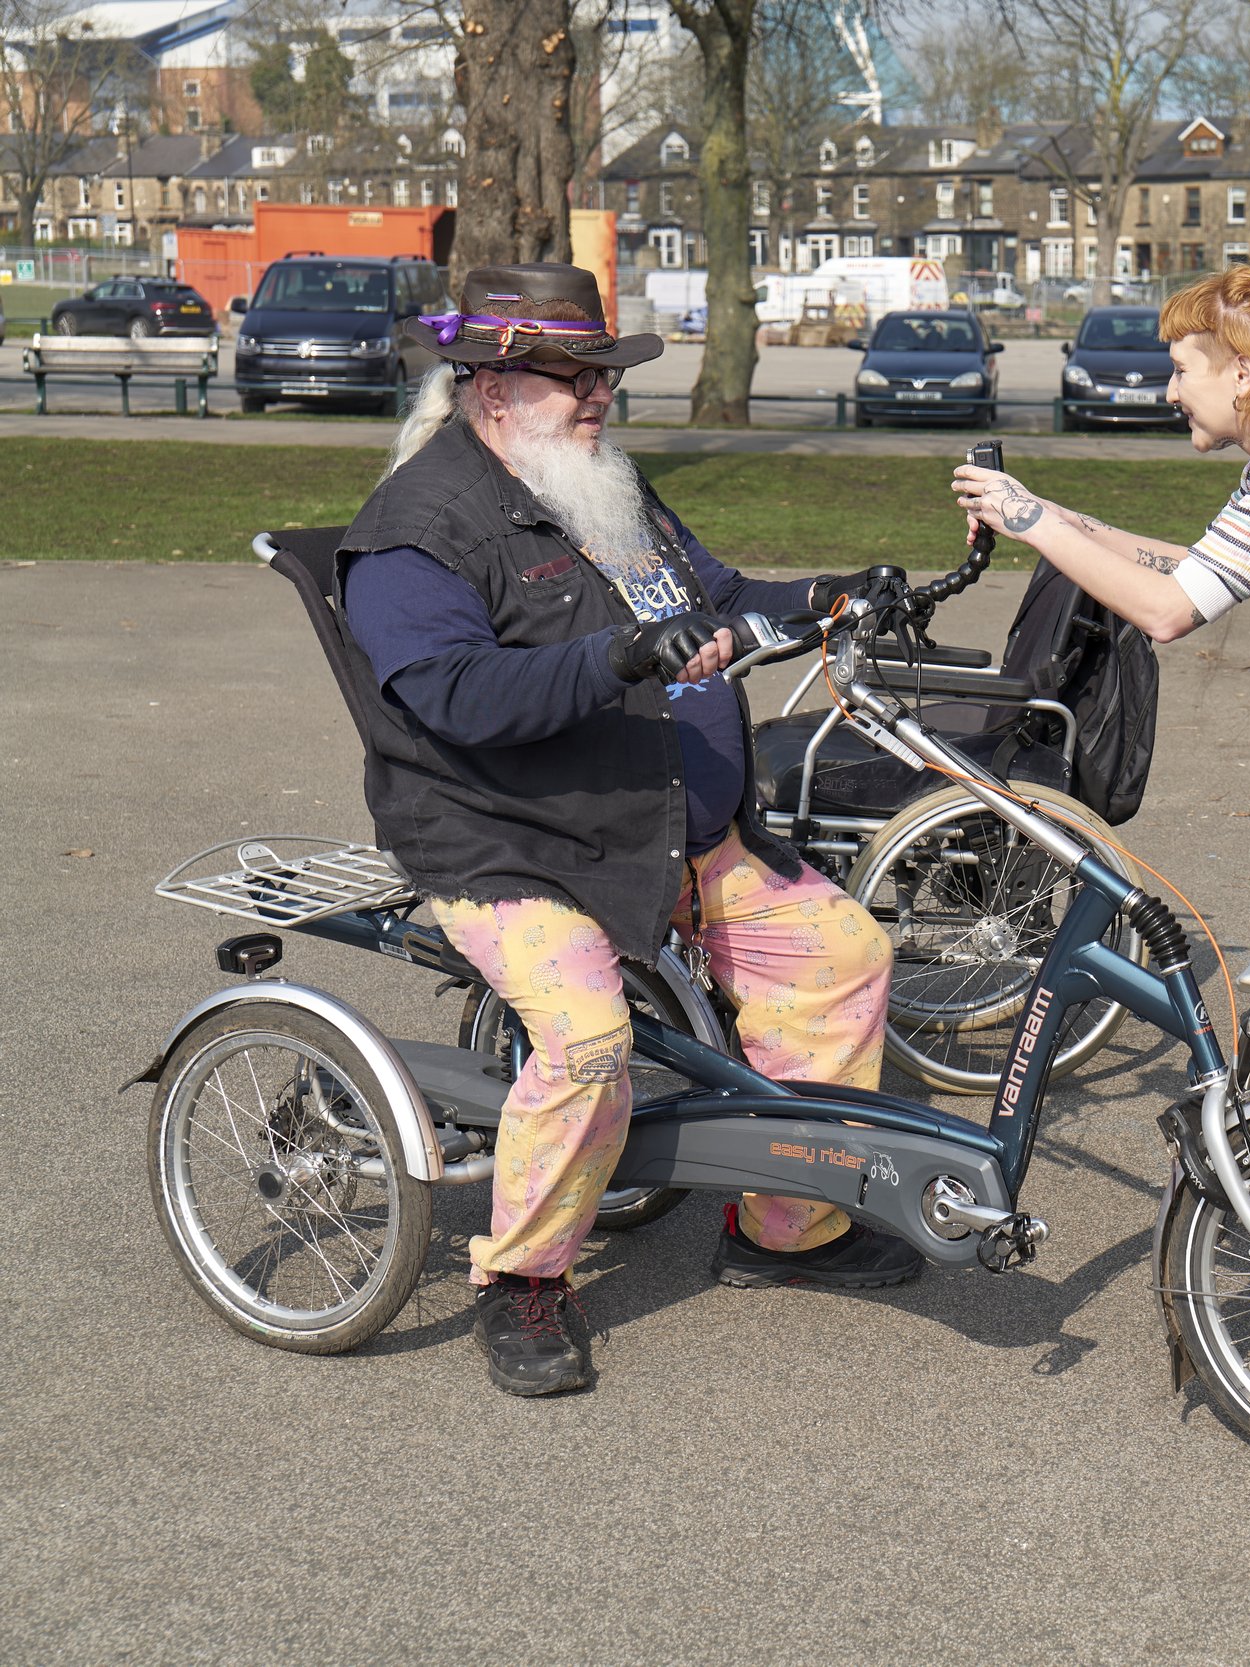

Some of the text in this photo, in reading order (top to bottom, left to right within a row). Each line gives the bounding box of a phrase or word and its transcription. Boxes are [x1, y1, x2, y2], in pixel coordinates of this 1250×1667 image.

[998, 986, 1054, 1117] vanraam
[769, 1142, 867, 1169] easy rider
